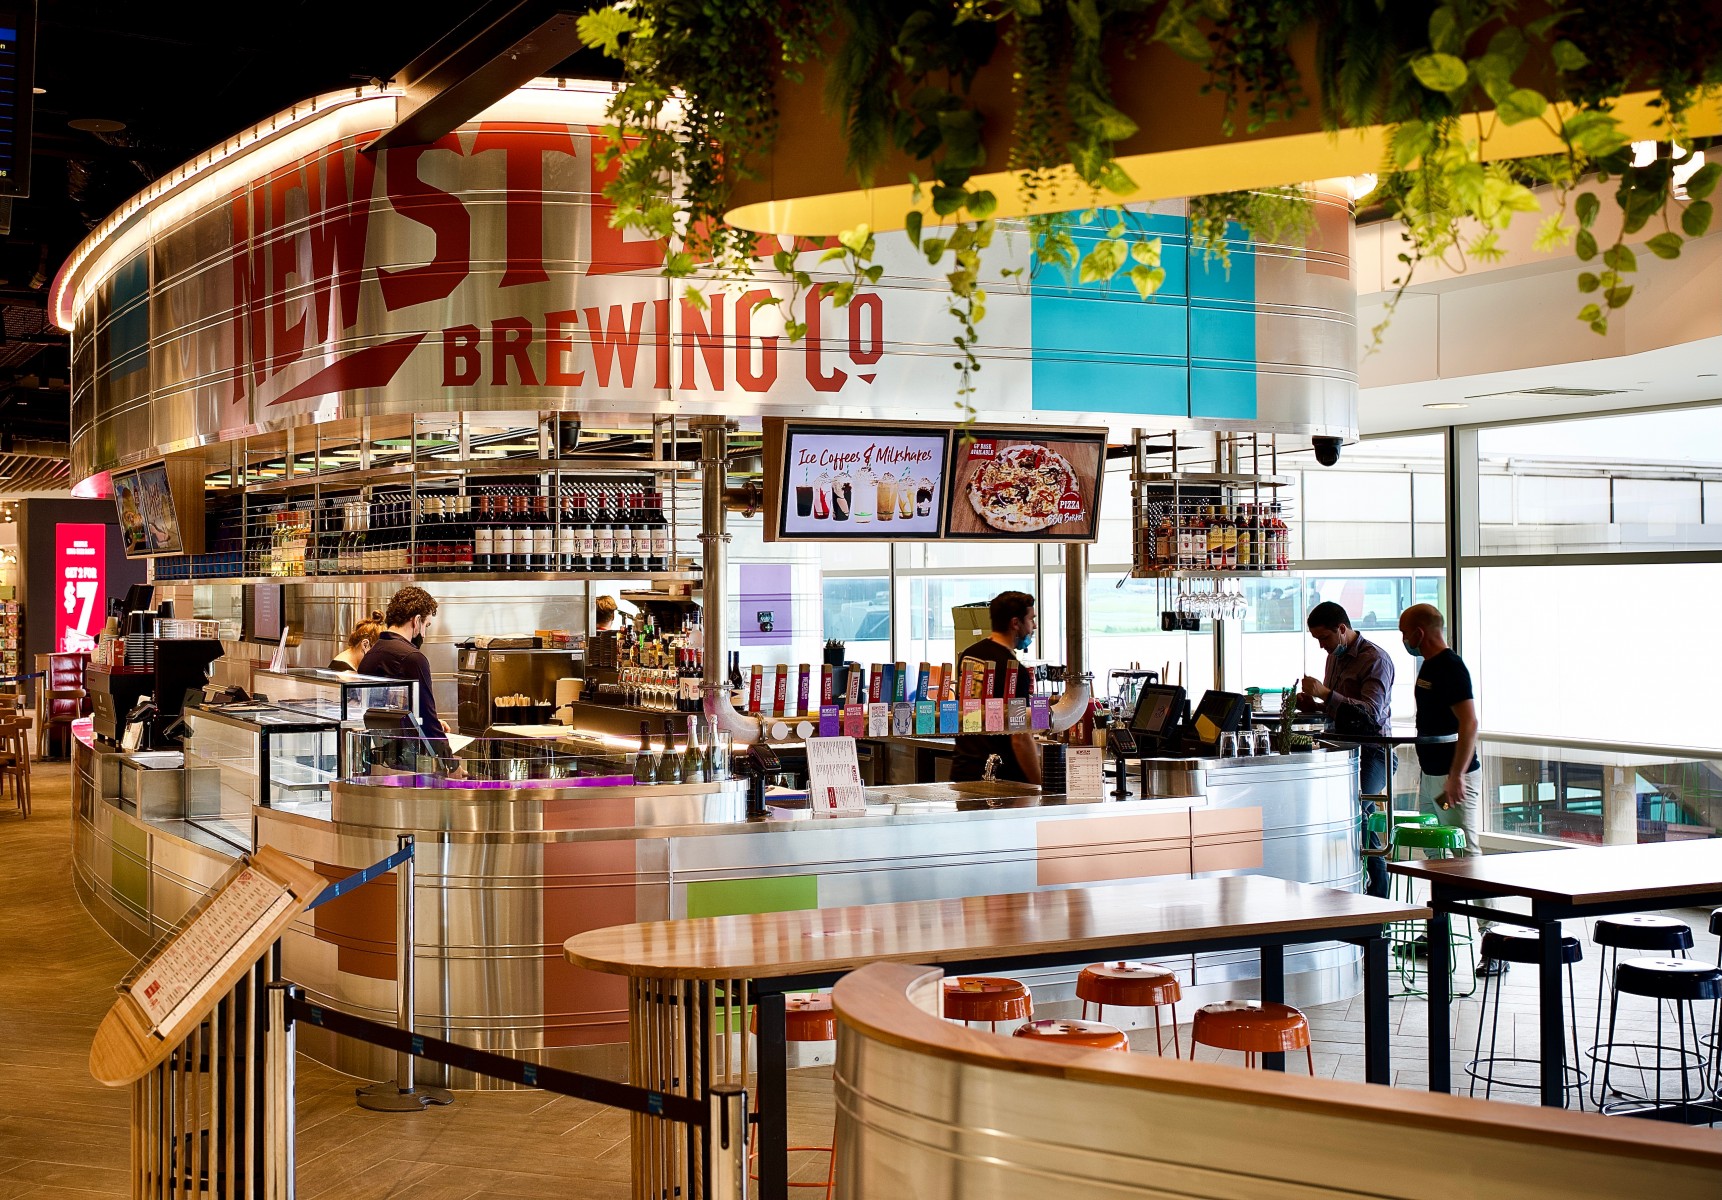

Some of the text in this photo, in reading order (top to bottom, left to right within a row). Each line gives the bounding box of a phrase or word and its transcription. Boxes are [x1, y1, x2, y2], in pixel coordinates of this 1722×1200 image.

[232, 119, 843, 406] NEWSTE
[441, 287, 780, 393] BREWING
[798, 443, 933, 470] Ice Coffees & Milkshakes
[1059, 500, 1080, 510] PIZZA
[84, 567, 97, 578] FOR
[64, 580, 98, 635] $7
